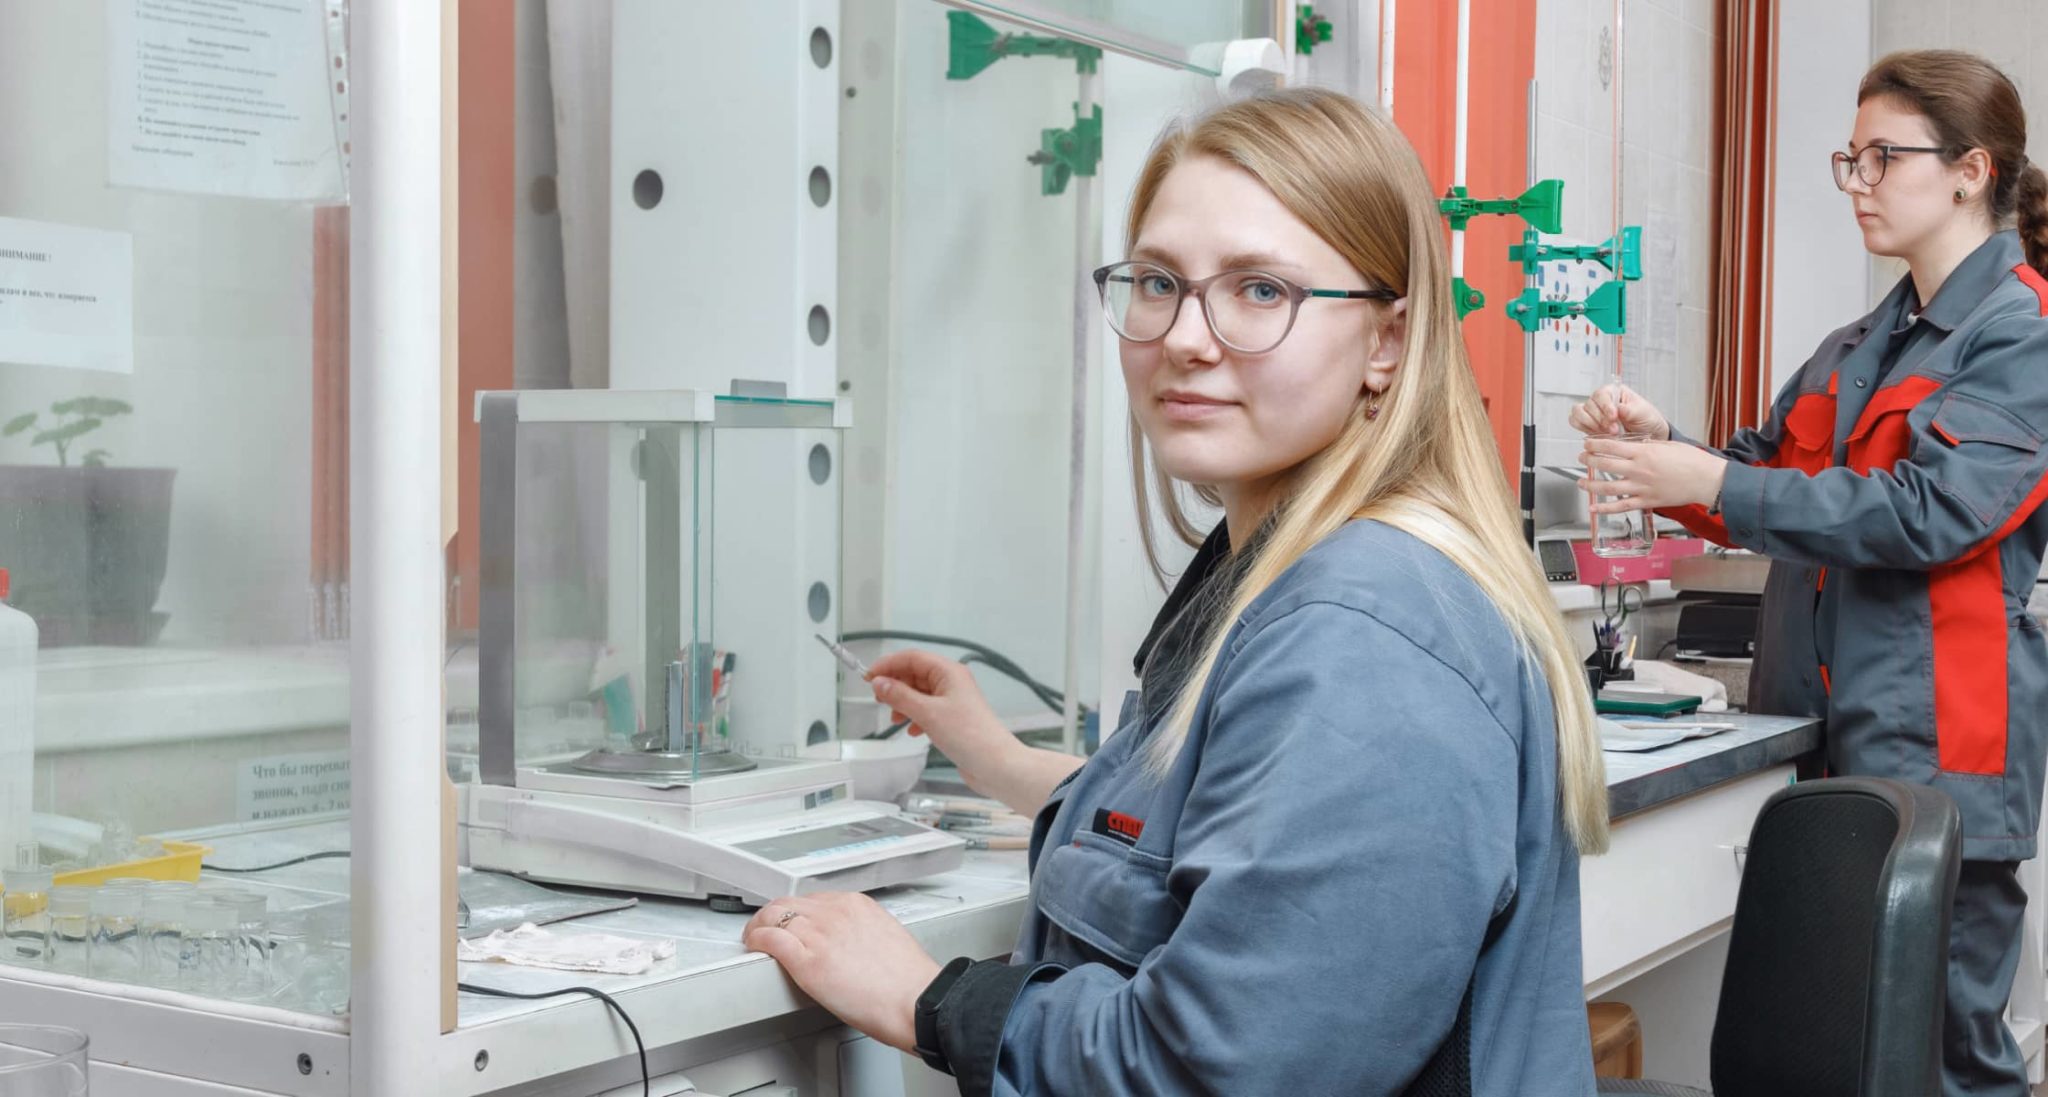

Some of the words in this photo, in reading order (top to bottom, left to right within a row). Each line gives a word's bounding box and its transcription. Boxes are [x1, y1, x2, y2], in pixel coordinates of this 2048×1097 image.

[0, 248, 46, 261] НИМАНИЕ
[253, 764, 276, 779] Что
[279, 763, 297, 776] бы
[252, 786, 298, 801] звонок,
[251, 811, 260, 820] и
[263, 806, 306, 820] нажать
